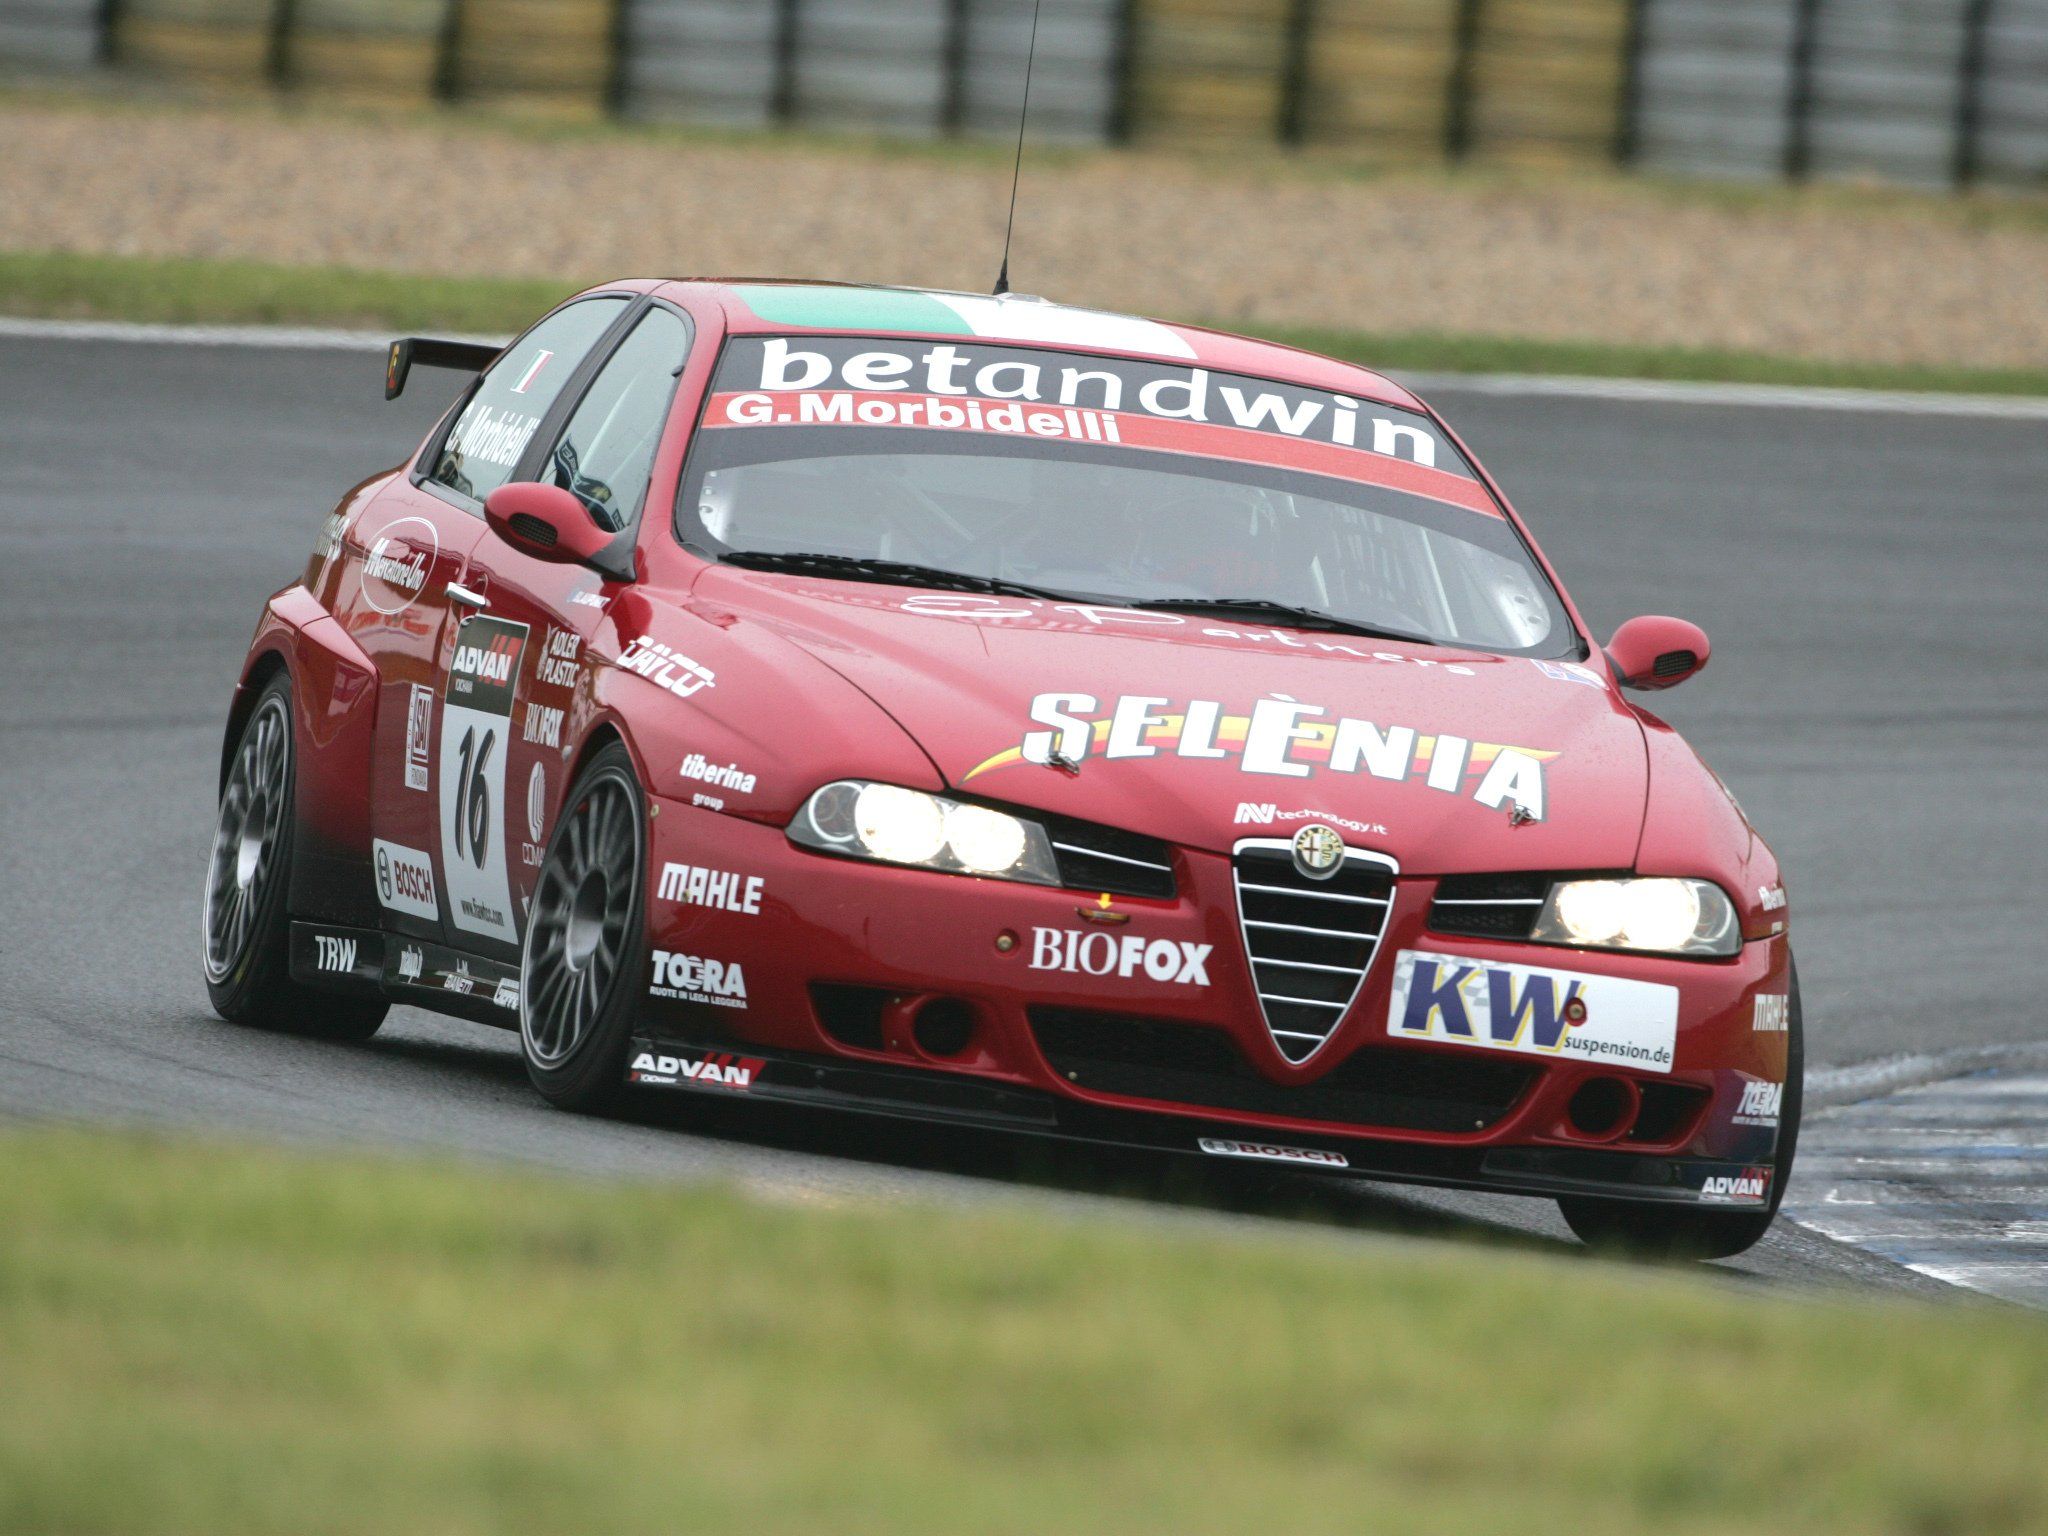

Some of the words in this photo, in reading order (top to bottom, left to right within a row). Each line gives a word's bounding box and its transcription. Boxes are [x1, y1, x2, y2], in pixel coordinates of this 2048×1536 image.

[724, 392, 1122, 445] G.Morbidelli
[760, 338, 1437, 469] betandwin
[451, 645, 512, 682] ADVAN
[549, 630, 581, 660] ADLER
[616, 634, 716, 698] DAYCO
[542, 657, 580, 689] PLASTIC
[522, 702, 565, 749] BIOFOX
[679, 753, 757, 794] tiberina
[1023, 692, 1548, 821] SELÈNIA
[455, 724, 496, 871] 16
[692, 792, 724, 811] group
[393, 859, 435, 905] BOSCH
[656, 861, 764, 916] MAHLE
[314, 935, 357, 973] TRW
[1028, 926, 1214, 986] BIOFOX
[1401, 958, 1588, 1055] KW
[1563, 1035, 1672, 1065] suspension.de
[630, 1052, 751, 1086] ADVAN
[1237, 1143, 1345, 1163] BOSCH
[1701, 1176, 1765, 1196] ADVAN
